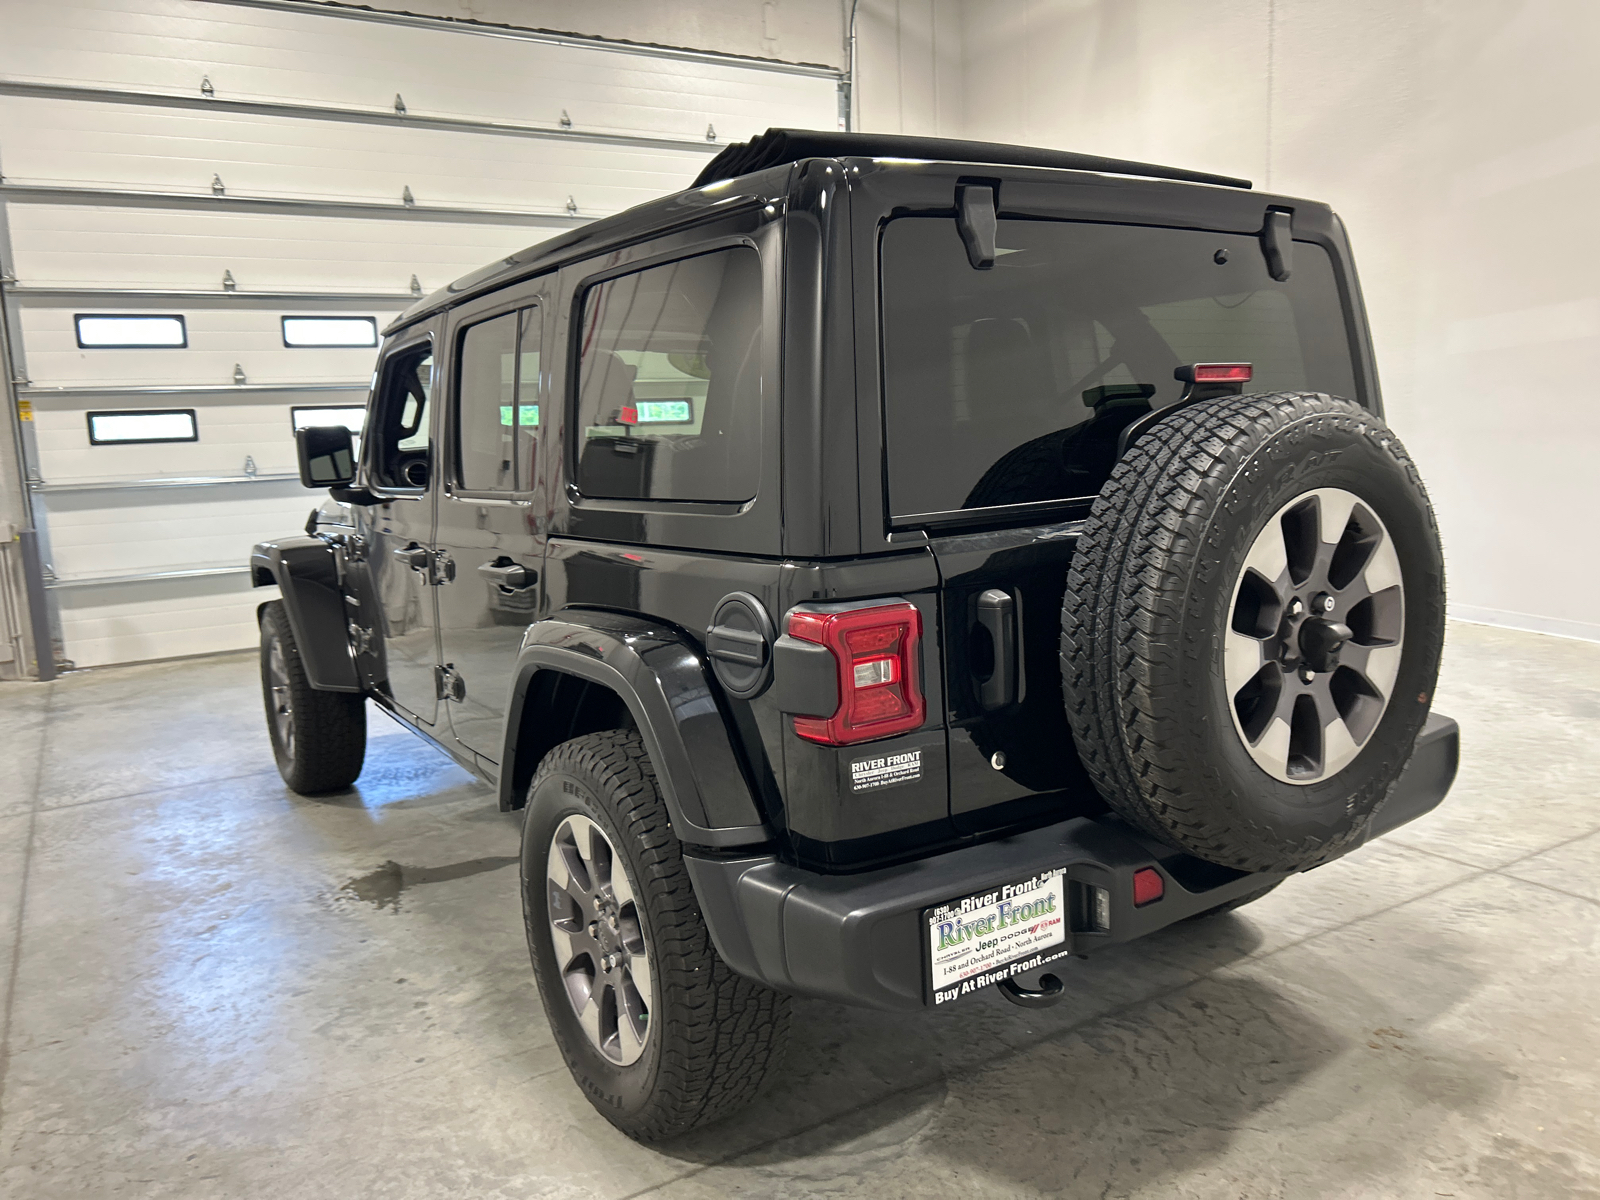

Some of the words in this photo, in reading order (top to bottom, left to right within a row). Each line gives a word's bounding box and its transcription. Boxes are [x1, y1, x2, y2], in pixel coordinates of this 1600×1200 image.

[852, 758, 885, 772] RIVER
[887, 751, 921, 766] FRONT
[961, 892, 998, 913] River
[1002, 877, 1037, 900] Front
[937, 913, 996, 951] River
[996, 892, 1056, 930] Front
[1000, 927, 1033, 942] DODGE
[1048, 918, 1061, 926] RAM
[943, 964, 957, 975] I-88
[958, 959, 969, 970] and
[971, 950, 994, 967] Orchard
[996, 945, 1011, 956] Road
[1015, 939, 1032, 950] North
[1033, 932, 1053, 943] Aurora
[976, 937, 998, 952] Jeep
[935, 988, 959, 1005] Buy
[961, 981, 975, 994] At
[977, 969, 1009, 989] River
